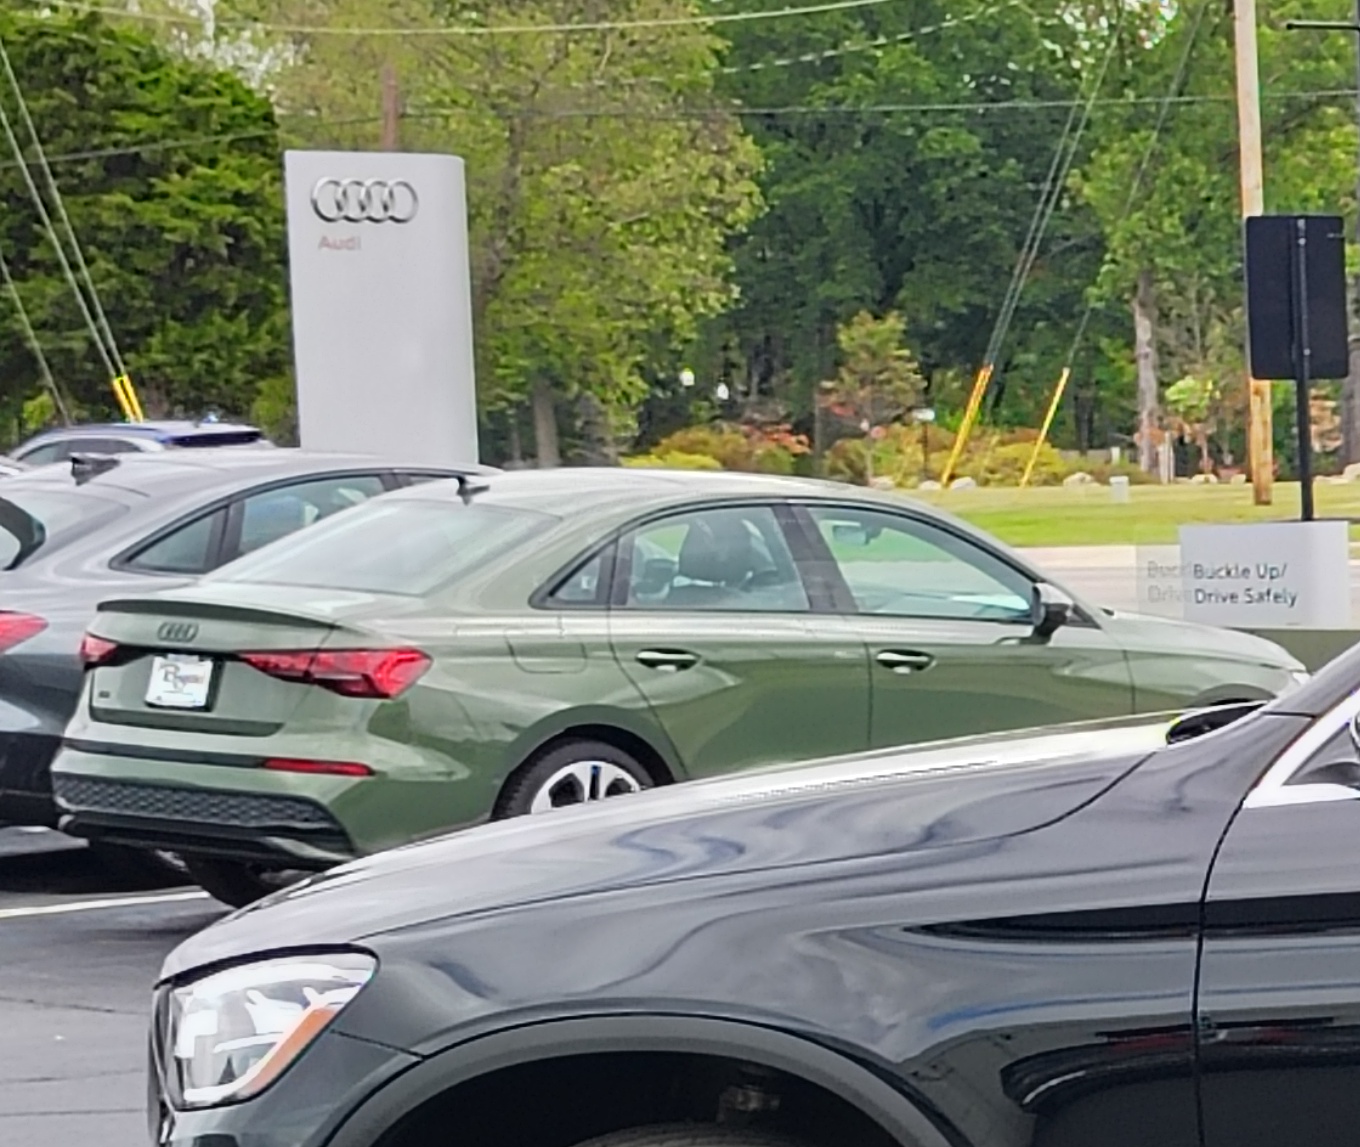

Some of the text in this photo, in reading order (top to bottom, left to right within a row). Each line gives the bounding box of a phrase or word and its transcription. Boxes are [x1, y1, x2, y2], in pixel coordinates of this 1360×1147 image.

[318, 235, 361, 250] Audi
[1193, 563, 1250, 579] Buckle
[1194, 586, 1297, 608] Drive Safely
